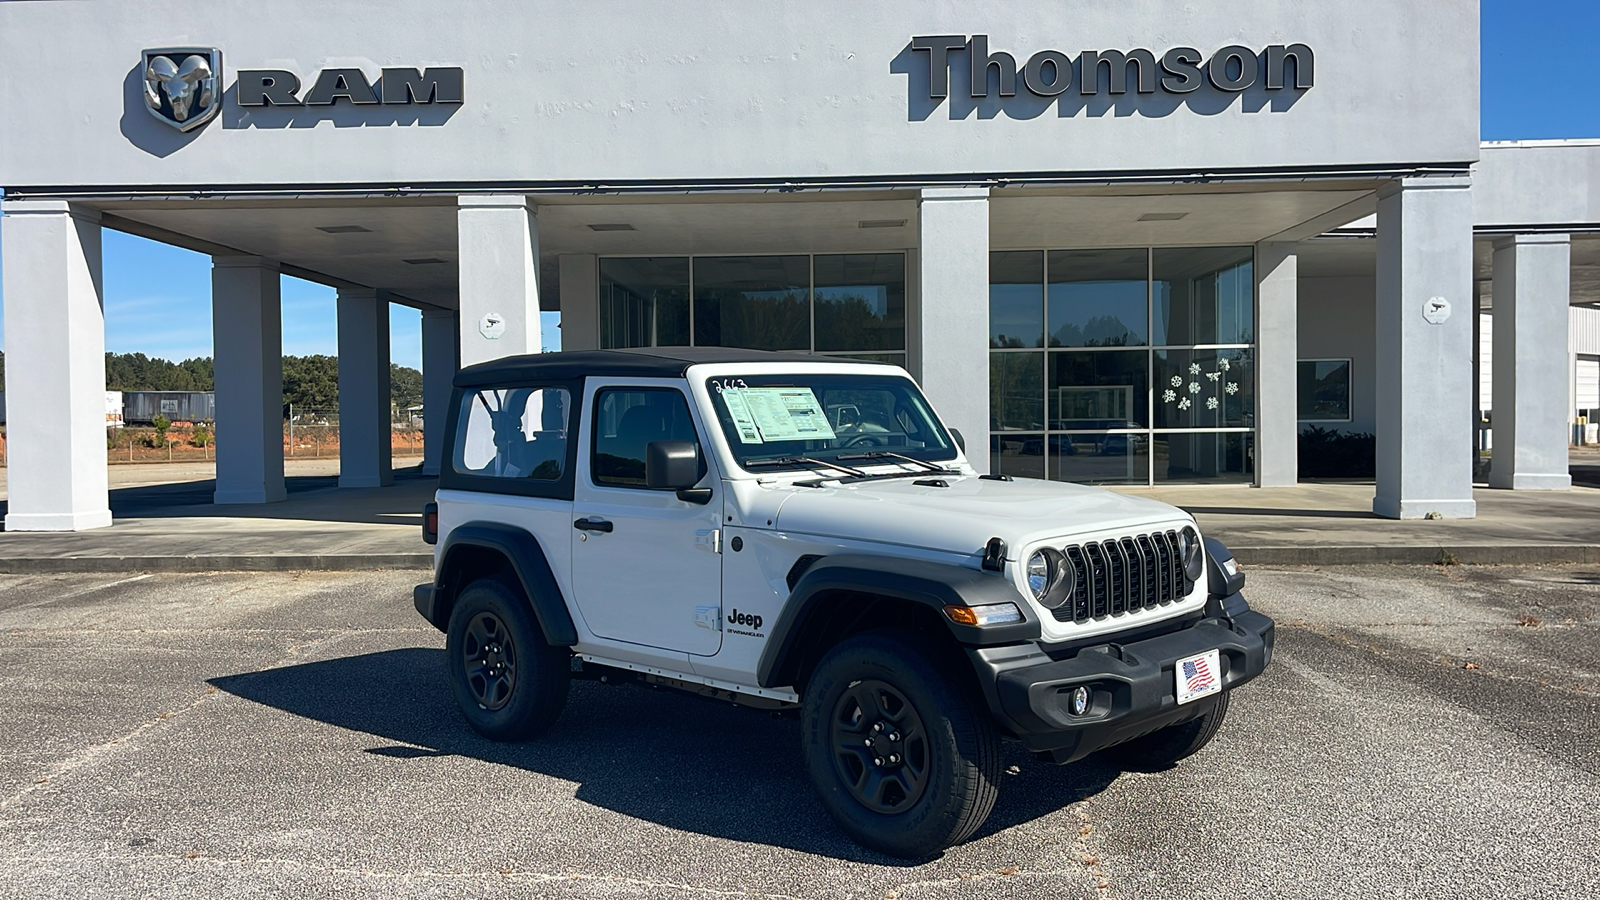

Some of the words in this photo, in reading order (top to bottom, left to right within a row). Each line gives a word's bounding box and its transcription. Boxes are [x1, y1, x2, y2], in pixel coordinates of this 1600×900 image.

[911, 34, 1316, 98] Thomson
[237, 67, 464, 106] RAM
[712, 379, 748, 393] 2663
[727, 608, 763, 629] Jeep
[732, 630, 764, 638] WRANGLER
